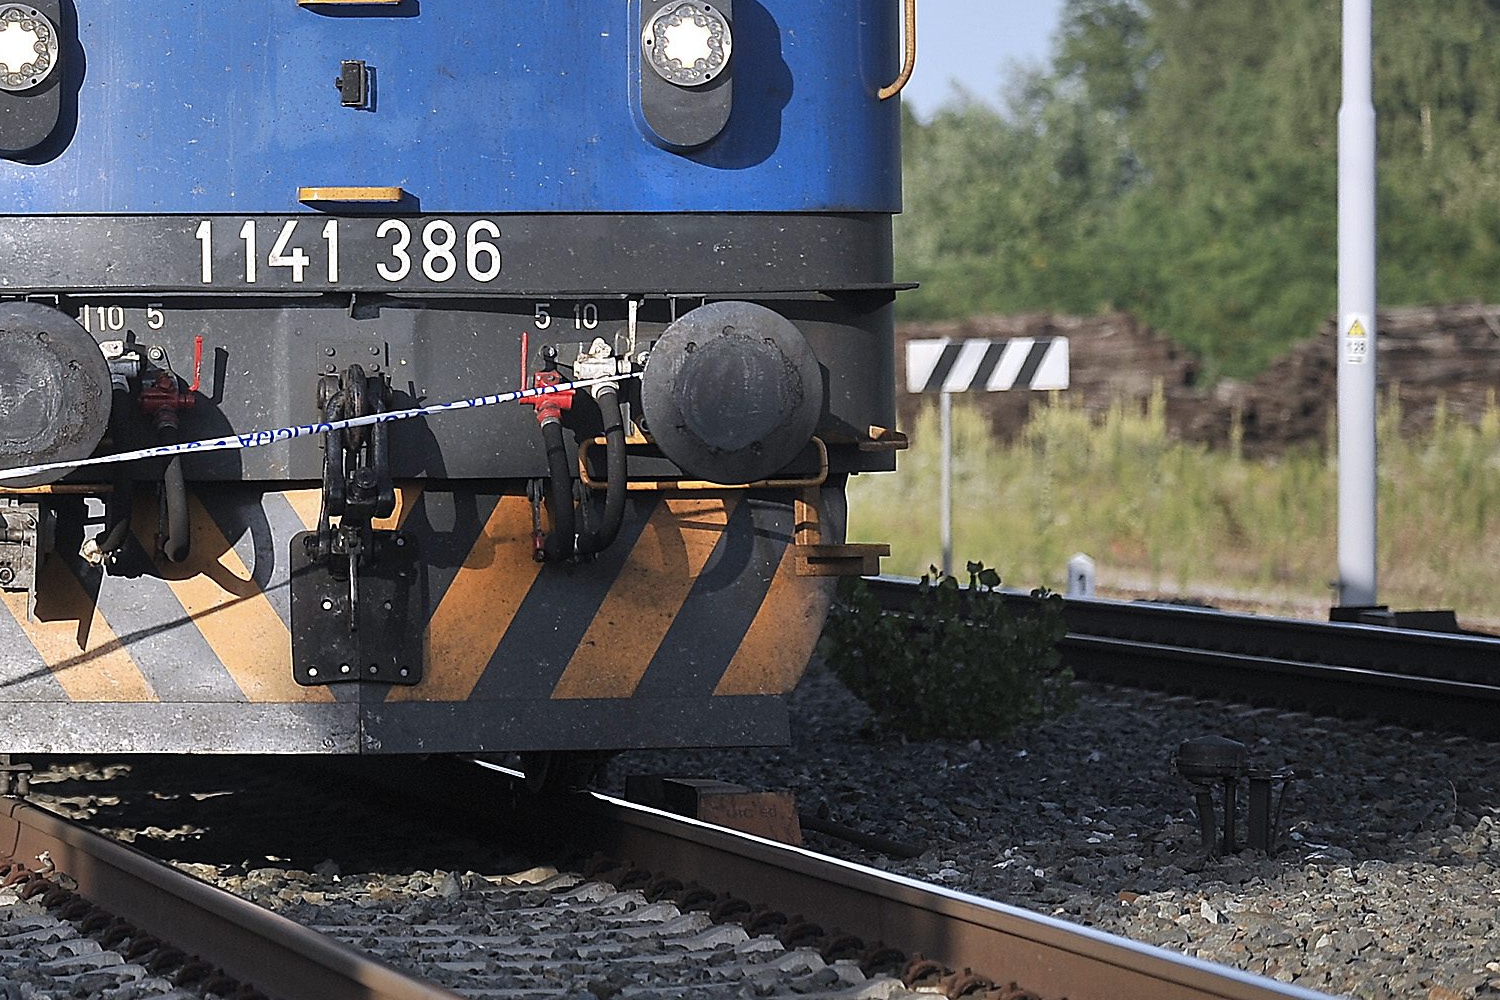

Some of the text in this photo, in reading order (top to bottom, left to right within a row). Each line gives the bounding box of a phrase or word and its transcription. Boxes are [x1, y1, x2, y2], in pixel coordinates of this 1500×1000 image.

[375, 218, 502, 282] 386
[96, 303, 165, 331] 10 5
[534, 303, 599, 330] 5 10
